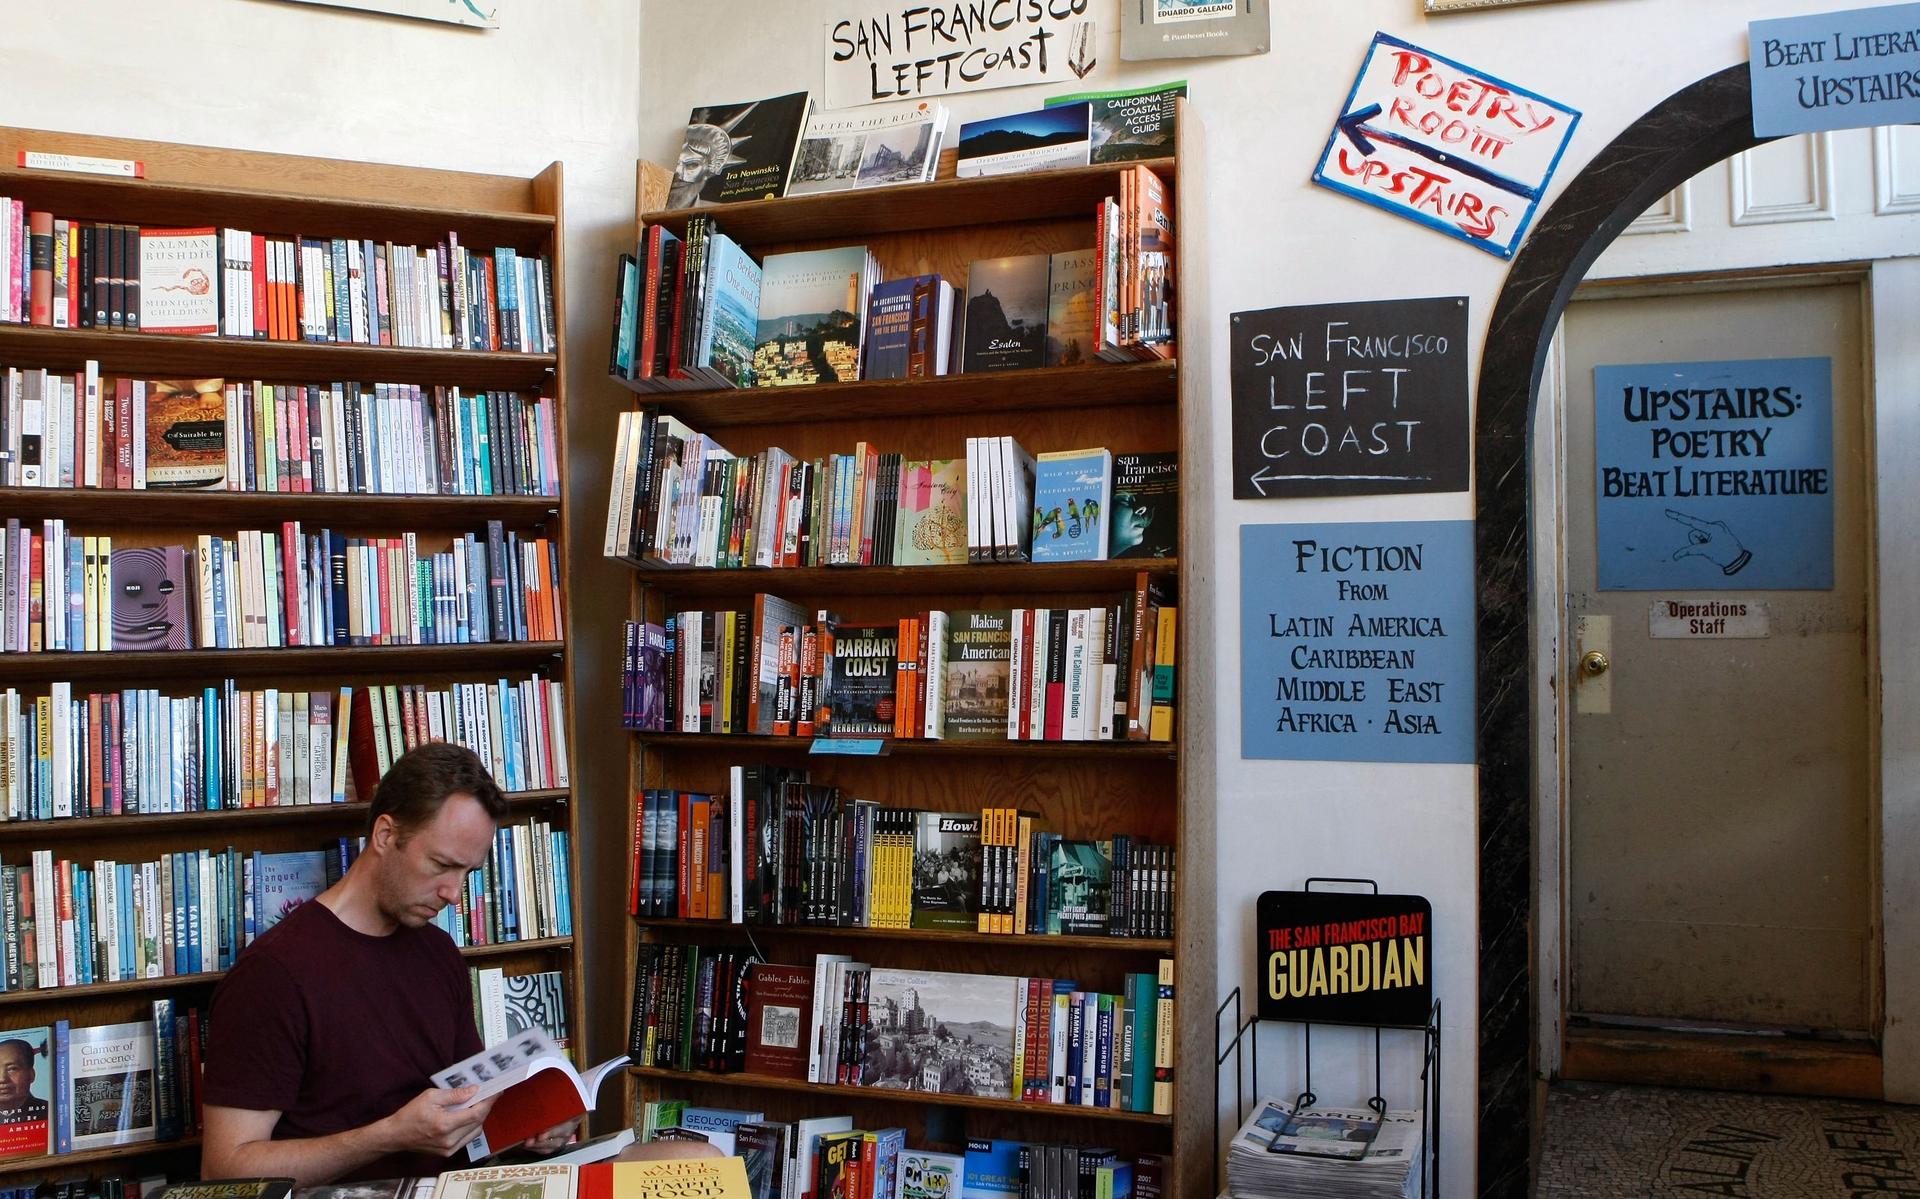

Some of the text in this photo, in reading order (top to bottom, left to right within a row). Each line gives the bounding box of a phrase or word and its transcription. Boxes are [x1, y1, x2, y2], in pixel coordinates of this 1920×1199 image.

[1158, 8, 1195, 18] EDUARDO
[1197, 4, 1233, 14] GALEANO
[832, 0, 1088, 63] SAN FRANCISCO
[1171, 30, 1229, 41] Pantheon Books
[1763, 39, 1826, 68] BEAT
[1107, 94, 1162, 110] CALIFORNIA
[1391, 51, 1555, 135] POETRY
[1120, 104, 1162, 118] COASTAL
[1125, 114, 1161, 127] ACCESS
[861, 117, 887, 127] THE
[1132, 123, 1160, 135] GUIDE
[1389, 97, 1513, 160] ROOM
[726, 164, 780, 181] Ira Nowinski's
[1338, 148, 1509, 239] UPSTAIRS
[146, 249, 213, 260] RUSHDIE
[149, 240, 209, 250] SALMAN
[339, 241, 350, 329] SALMAN RUSHDIE
[151, 308, 208, 317] CHILDREN
[988, 338, 1021, 350] Esalen
[1251, 321, 1448, 366] SAN FRANCISCO
[1270, 368, 1412, 410] LEFT
[1623, 386, 1802, 423] UPSTAIRS:
[179, 430, 223, 439] Suitable Boy
[1261, 420, 1421, 459] COAST
[1651, 427, 1772, 459] POETRY
[1117, 455, 1139, 465] san
[152, 468, 195, 477] VIKRAM
[1117, 474, 1145, 485] noir
[1602, 466, 1828, 498] BEAT LITERATURE
[1292, 540, 1423, 573] FICTION
[1337, 580, 1389, 601] FROM
[1135, 590, 1145, 641] First Families
[1669, 602, 1747, 619] Operations
[970, 615, 1004, 630] Making
[1269, 613, 1448, 638] LATIN AMERICA
[1690, 618, 1726, 634] Staff
[863, 629, 875, 638] THE
[953, 631, 970, 643] SAN
[836, 639, 897, 657] BARBARY
[961, 643, 1010, 659] American
[1291, 645, 1415, 670] CARIBBEAN
[845, 657, 889, 677] COAST
[1071, 645, 1083, 718] The California Indians
[1276, 677, 1445, 703] MIDDLE EAST
[832, 723, 864, 734] HERBERT
[1276, 707, 1442, 735] AFRICA ASIA
[941, 820, 978, 832] Howl
[6, 907, 14, 932] STRAIN
[176, 907, 185, 947] KARAN
[189, 905, 198, 946] KARAN
[7, 933, 14, 941] OF
[1269, 911, 1424, 950] THE SAN FRANCISCO BAY
[8, 943, 17, 975] MEETING
[1268, 935, 1424, 1000] GUARDIAN
[758, 973, 810, 985] Gables Fables
[1072, 1007, 1080, 1047] MAMMALS
[1025, 1000, 1038, 1077] DEVIL'S TEETH
[1037, 1000, 1050, 1077] DEVIL'S TEETH
[1123, 1025, 1132, 1062] CALIFAUNA
[81, 1041, 134, 1057] Clamor of
[82, 1054, 135, 1067] Innocence
